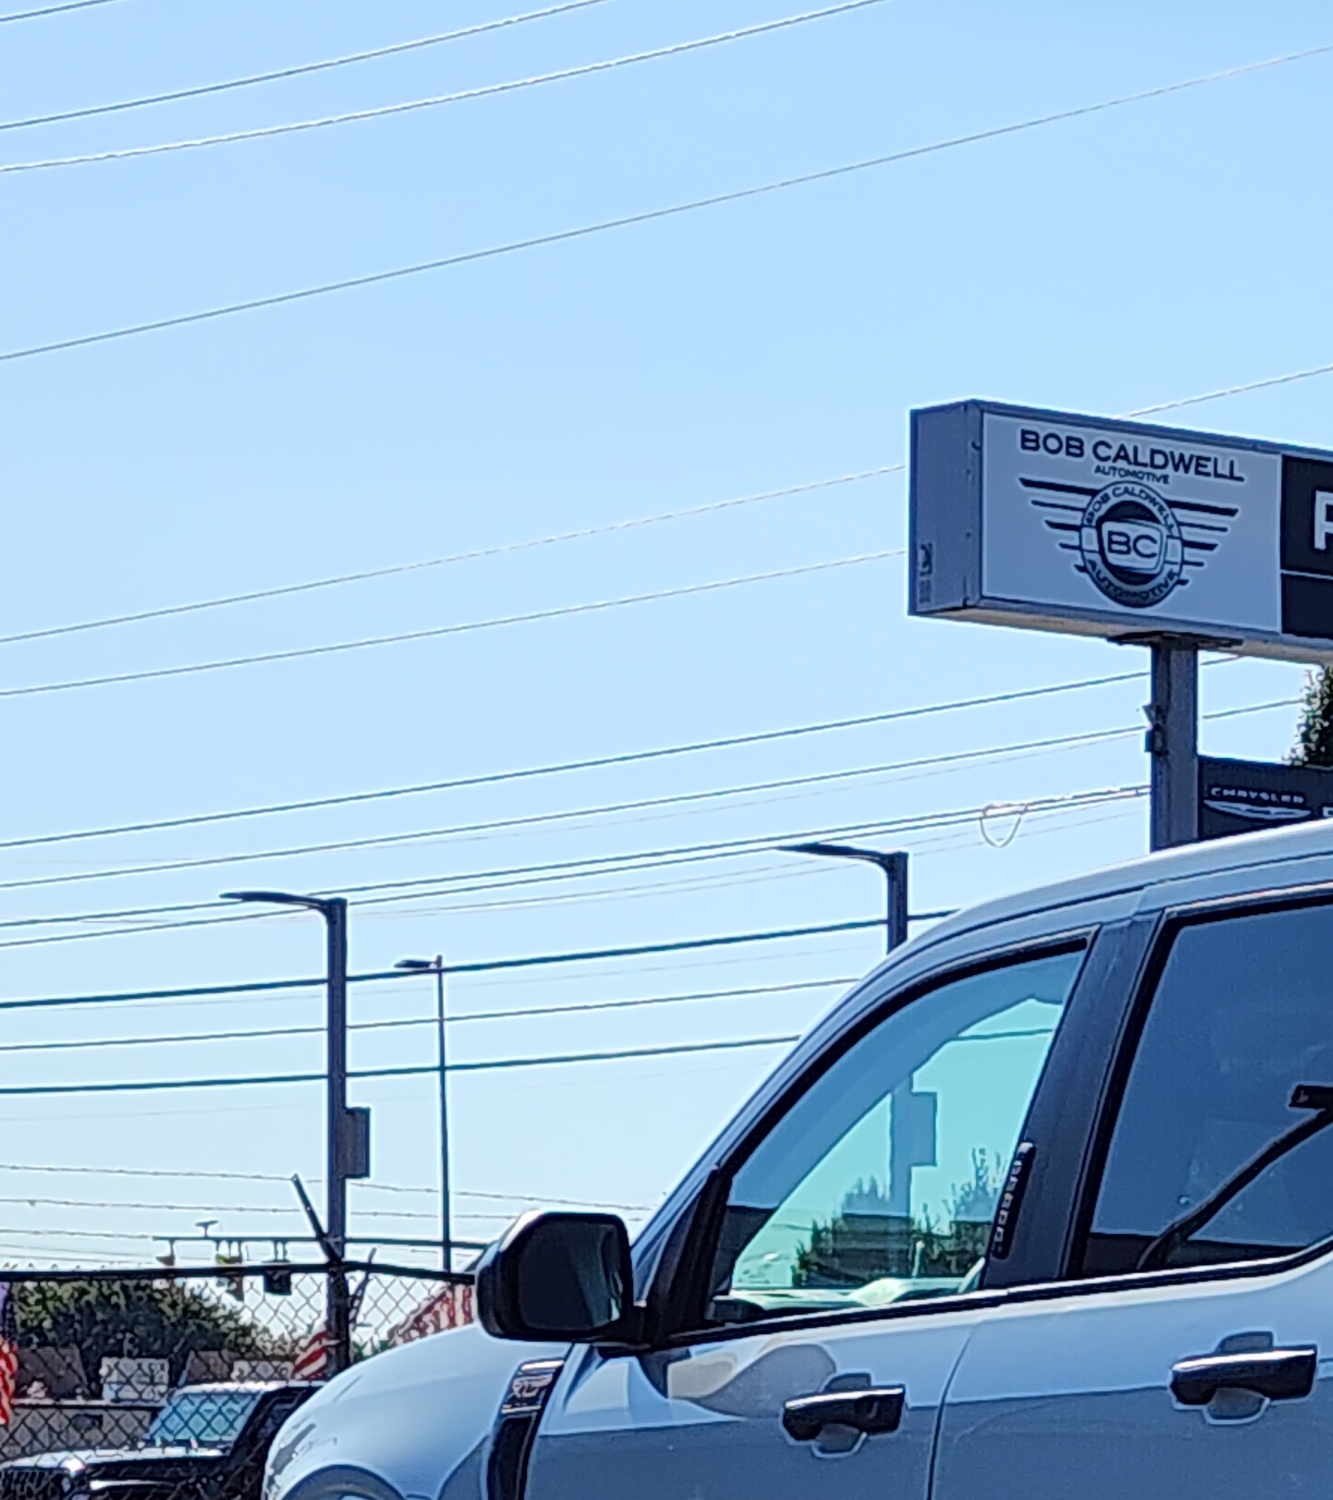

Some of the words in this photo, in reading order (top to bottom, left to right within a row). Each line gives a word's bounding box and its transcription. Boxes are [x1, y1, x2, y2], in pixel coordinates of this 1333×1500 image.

[1021, 429, 1084, 457] BOB
[1092, 441, 1244, 482] CALDWELL
[1094, 465, 1170, 484] AUTOMOTIVE
[1107, 530, 1158, 559] BC
[1210, 787, 1305, 804] CHRYSLER
